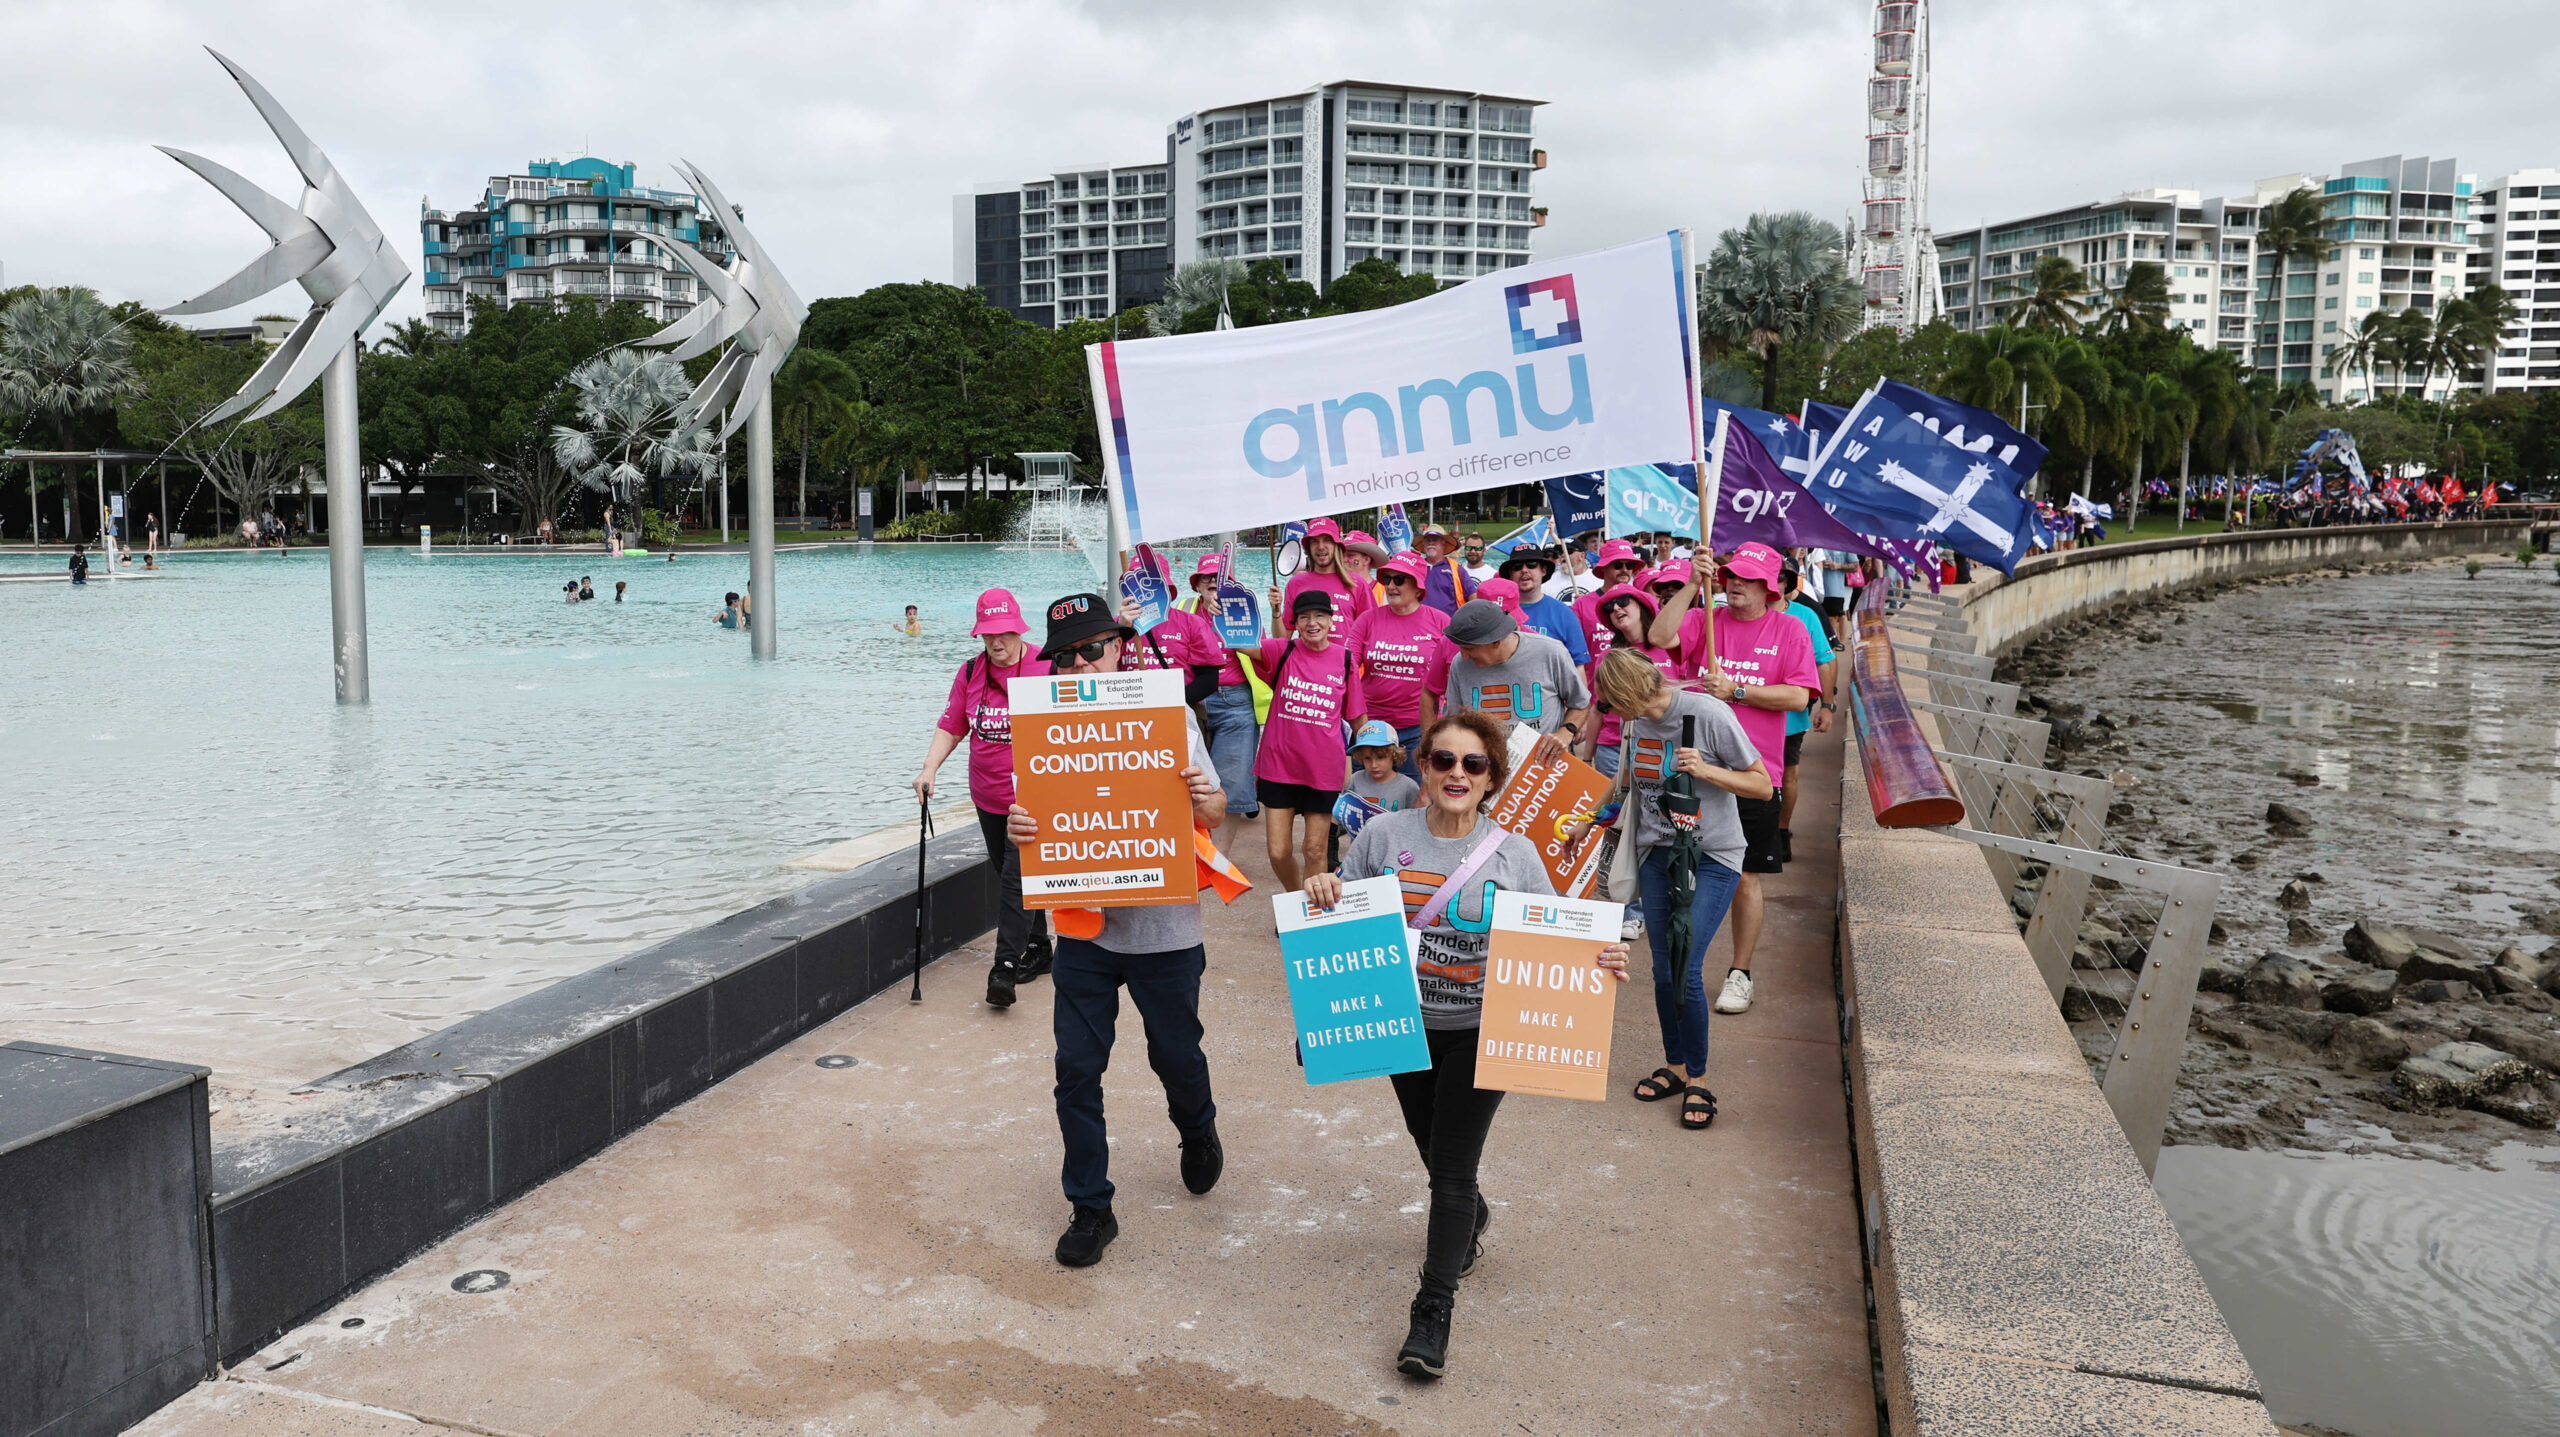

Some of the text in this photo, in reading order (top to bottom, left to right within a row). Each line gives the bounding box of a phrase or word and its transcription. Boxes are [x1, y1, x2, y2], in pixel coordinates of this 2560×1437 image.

[1243, 354, 1594, 501] qnmu
[1333, 445, 1572, 497] making a difference
[1570, 512, 1593, 523] AWU
[984, 603, 1008, 616] qnmu
[1052, 597, 1089, 620] QTU
[1226, 628, 1253, 639] qnmu
[1374, 640, 1419, 652] Nurses
[1753, 645, 1779, 656] qnmu
[1366, 650, 1425, 664] Midwives
[1373, 662, 1415, 675] Carers
[1697, 665, 1766, 687] Mwives
[1051, 677, 1143, 703] IEU Independent
[1287, 675, 1333, 695] Nurses
[1280, 687, 1336, 709] Midwives
[1284, 701, 1327, 719] Carers
[1046, 720, 1153, 745] QUALITY
[1029, 749, 1175, 775] CONDITIONS
[1096, 786, 1111, 797] =
[1496, 759, 1545, 826] QUALITY
[1512, 759, 1570, 836] ONDITIONS
[1052, 808, 1159, 833] QUALITY
[1040, 837, 1177, 861] EDUCATION
[1045, 872, 1159, 889] www.qieu.asn.au
[1522, 904, 1593, 925] IEU Independent
[1565, 914, 1593, 922] Education
[1293, 945, 1401, 980] TEACHERS
[1419, 978, 1467, 992] making
[1496, 957, 1604, 995] UNIONS
[1330, 993, 1383, 1014] MAKE A
[1421, 991, 1483, 1006] ifference
[1519, 1010, 1574, 1029] MAKE A
[1306, 1017, 1417, 1048] DIFFERENCE!
[1485, 1039, 1602, 1067] DIFFERENCE!
